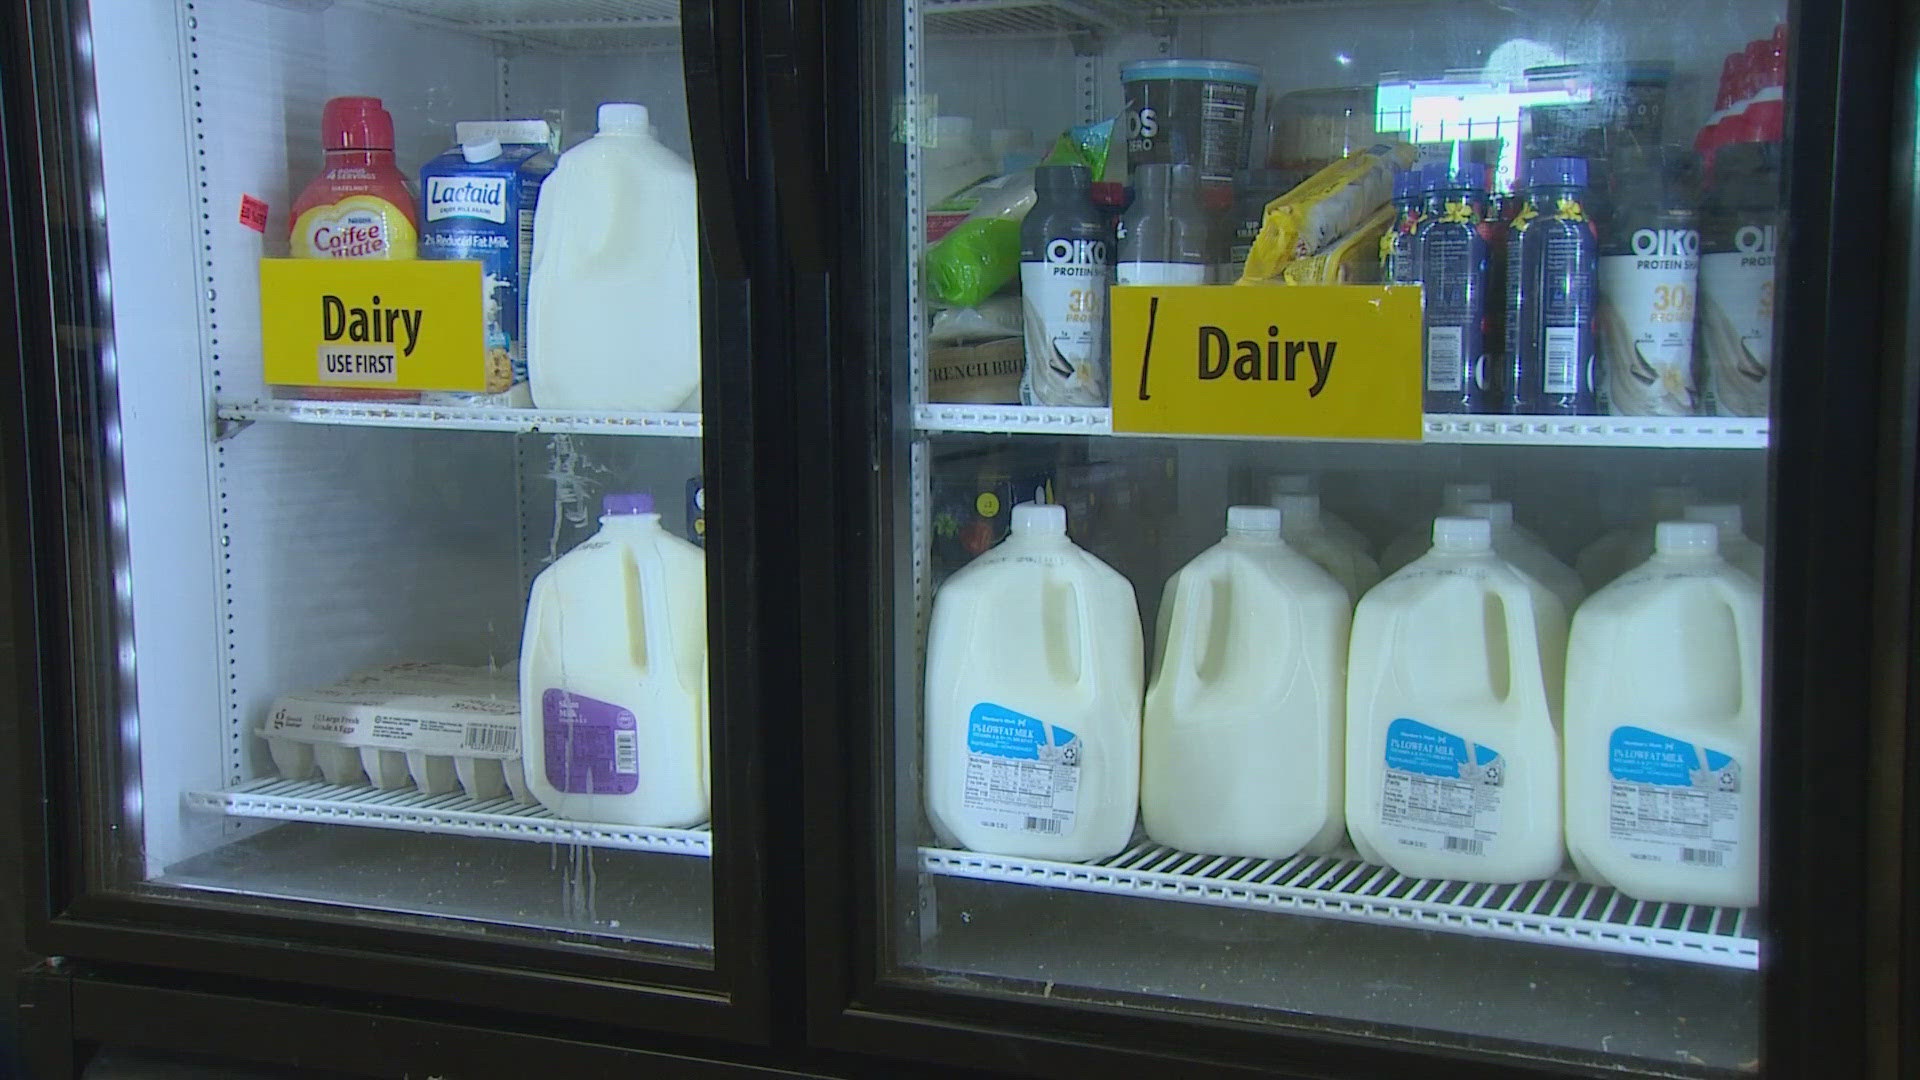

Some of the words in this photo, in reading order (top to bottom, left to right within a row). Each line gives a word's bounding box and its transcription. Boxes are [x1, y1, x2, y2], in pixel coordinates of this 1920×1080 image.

[431, 180, 501, 206] Lactaid
[313, 224, 380, 252] Coffee
[436, 233, 472, 248] Reduced
[473, 233, 488, 247] Fat
[489, 233, 509, 249] Milk
[331, 238, 384, 258] mate
[1637, 260, 1682, 270] PROTEIN
[322, 295, 423, 357] Dairy
[326, 354, 353, 373] USE
[355, 354, 394, 374] FIRST
[1198, 325, 1337, 398] Dairy
[341, 715, 360, 725] Fresh
[340, 725, 356, 734] Eggs
[984, 724, 1013, 737] LOWFAT
[1014, 727, 1035, 738] MILK
[1400, 739, 1433, 753] LOWFAT
[1434, 744, 1455, 756] MILK
[1625, 749, 1661, 760] LOWFAT
[1661, 752, 1685, 764] MILK
